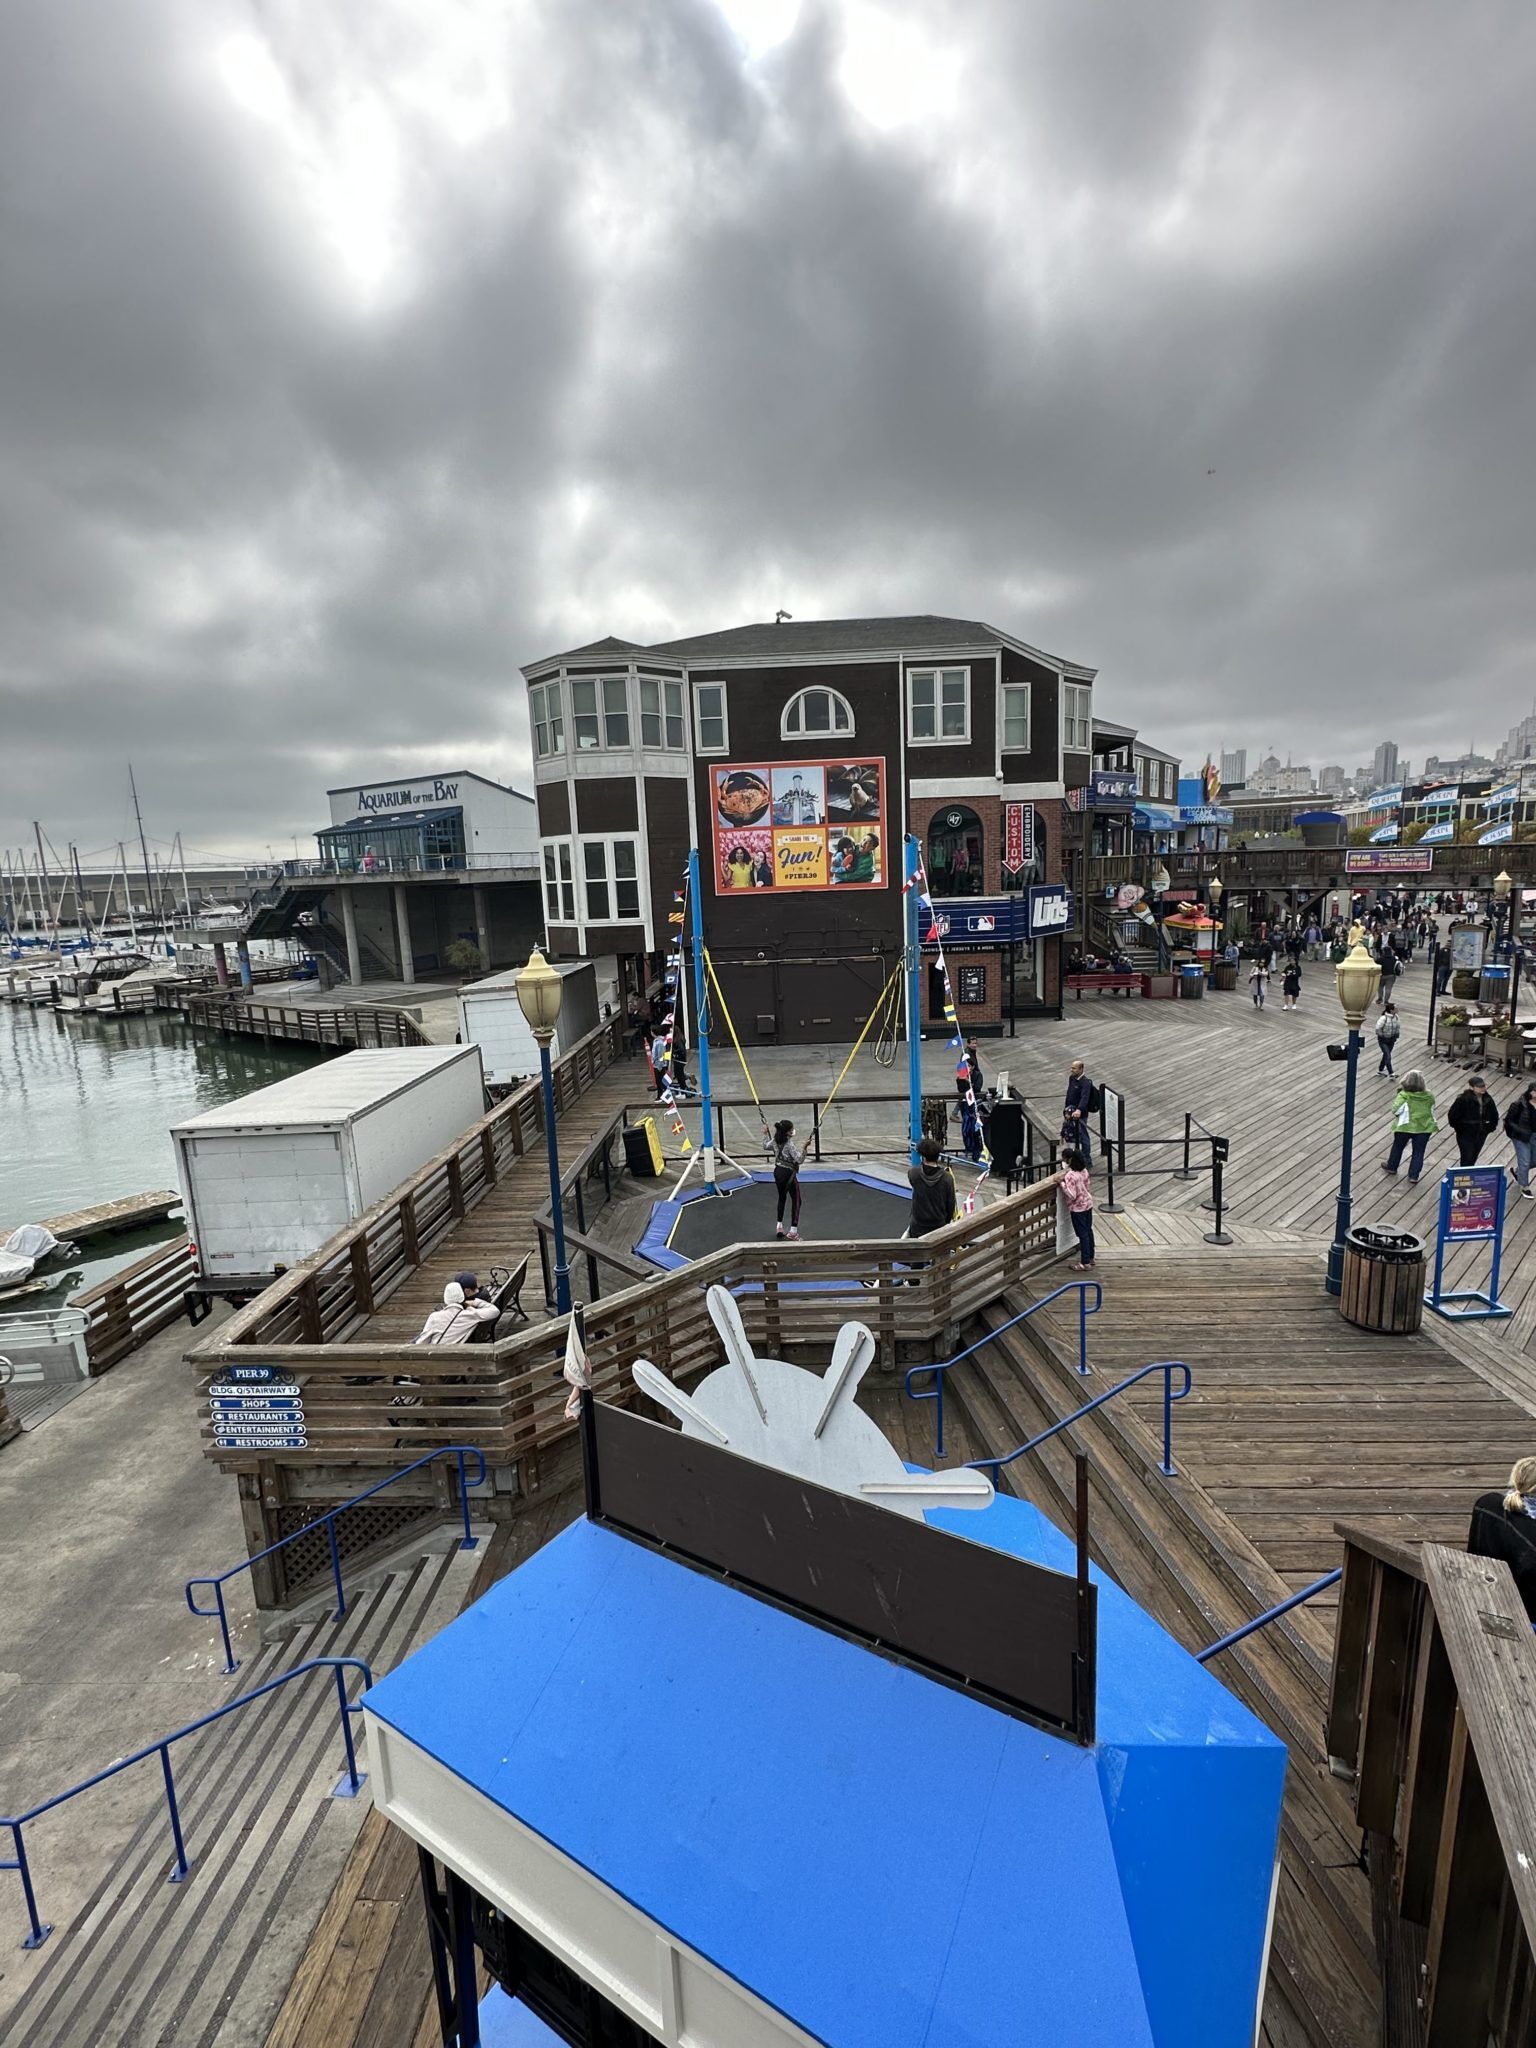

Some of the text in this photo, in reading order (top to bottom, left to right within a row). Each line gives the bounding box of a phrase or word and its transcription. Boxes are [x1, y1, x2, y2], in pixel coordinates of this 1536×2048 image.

[434, 780, 459, 801] BAY
[1010, 806, 1019, 867] CUSTOM
[235, 1369, 269, 1378] PIER 39
[237, 1387, 286, 1395] Q/STAIRWAY
[289, 1386, 298, 1394] 12
[241, 1400, 271, 1408] SHOPS
[228, 1413, 289, 1421] RESTAURANTS
[226, 1426, 295, 1434] ENTERTAINMENT
[235, 1439, 288, 1447] RESTROOMS
